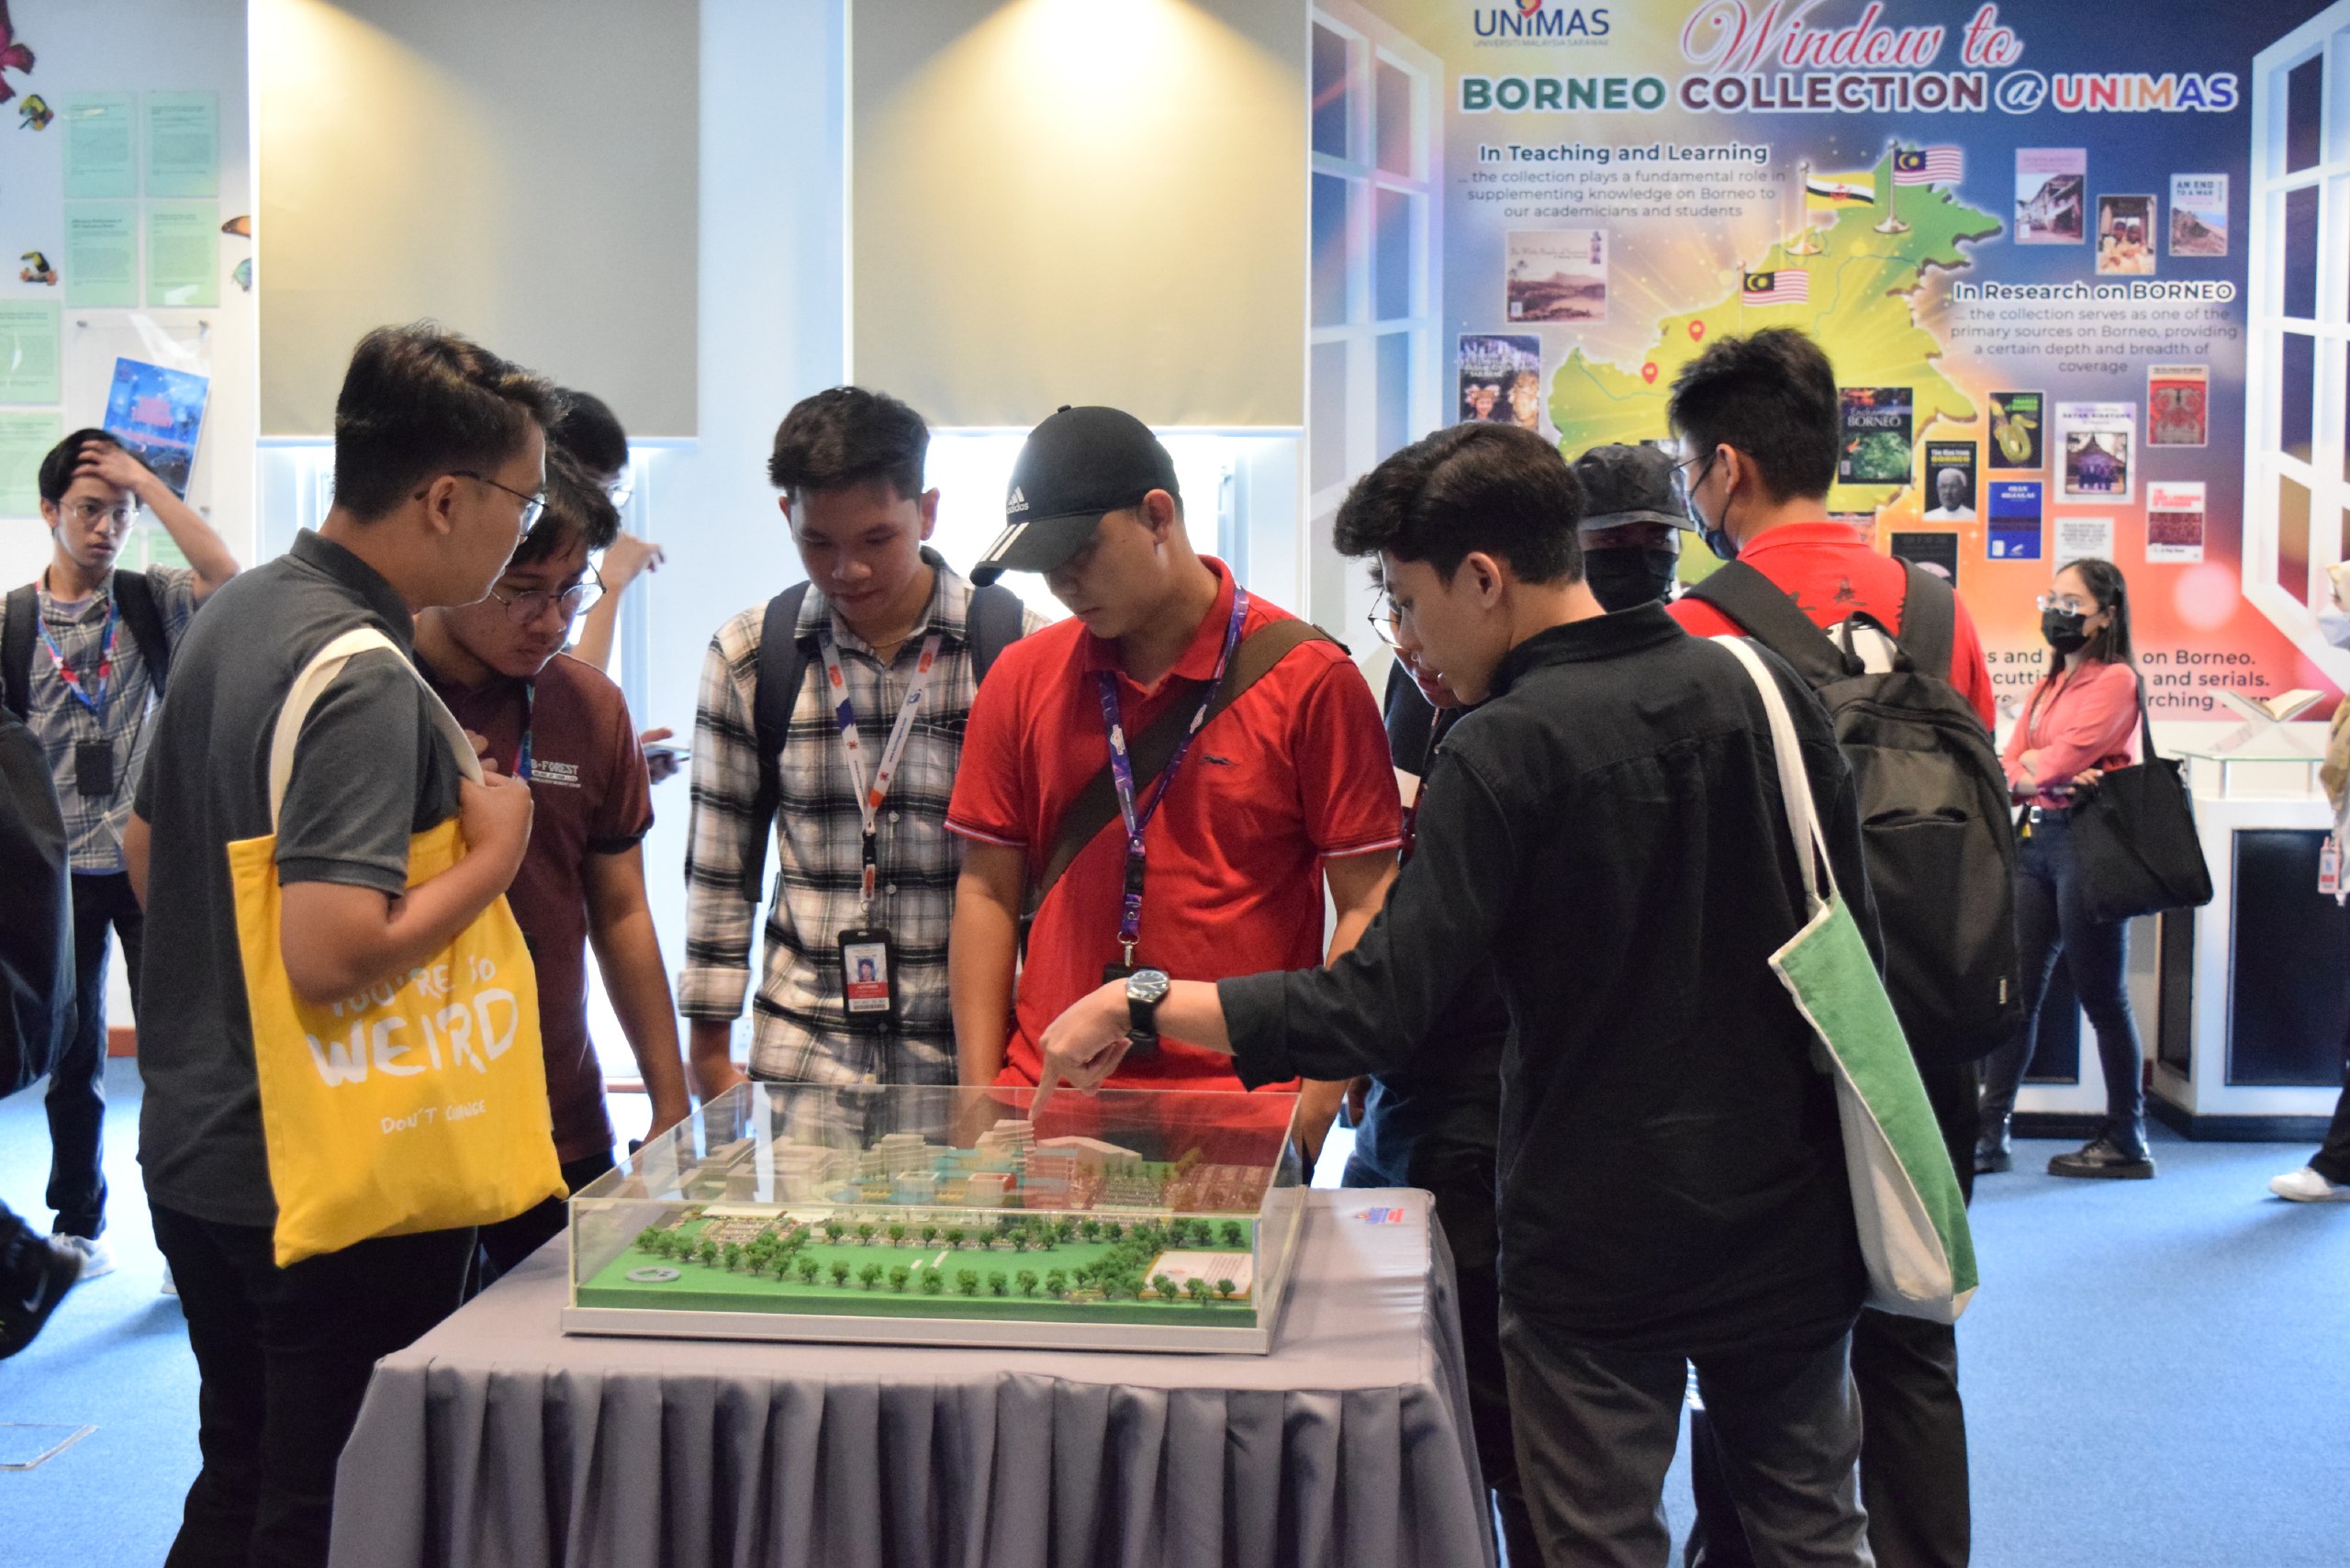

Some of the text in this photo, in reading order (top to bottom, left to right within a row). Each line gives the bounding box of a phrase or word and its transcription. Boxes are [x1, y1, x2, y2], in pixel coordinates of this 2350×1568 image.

[1683, 0, 2022, 73] Window to
[1463, 70, 2234, 114] BORNEO COLLECTION @ UNIMAS
[1480, 143, 1768, 164] In Teaching and Learning
[1472, 171, 1497, 183] the
[1502, 170, 1575, 184] collection
[1579, 171, 1618, 186] plays
[1622, 174, 1631, 183] a
[1636, 170, 1734, 183] fundamental
[1739, 171, 1768, 183] role
[1772, 171, 1786, 183] in
[1467, 187, 1776, 203] supplementing knowledge on Borneo to
[1504, 205, 1743, 218] our academicians and students
[1955, 282, 2233, 299] In Research on BORNEO
[1969, 308, 1996, 320] the
[1999, 308, 2075, 320] collection
[2078, 310, 2130, 320] serves
[2132, 310, 2148, 320] as
[2151, 310, 2182, 320] one
[2185, 308, 2201, 320] of
[2203, 308, 2230, 320] the
[1950, 325, 2010, 342] primary
[2014, 328, 2074, 338] sources
[2076, 328, 2098, 338] on
[2165, 325, 2237, 342] providing
[1974, 342, 2210, 357] a certain depth and breadth of
[2058, 361, 2128, 375] coverage
[1847, 416, 1902, 427] BORNEO
[2004, 648, 2042, 664] and
[2142, 652, 2167, 665] on
[2176, 650, 2256, 666] Borneo.
[1992, 669, 2271, 687] cutti and serials.
[307, 988, 520, 1087] WEIRD
